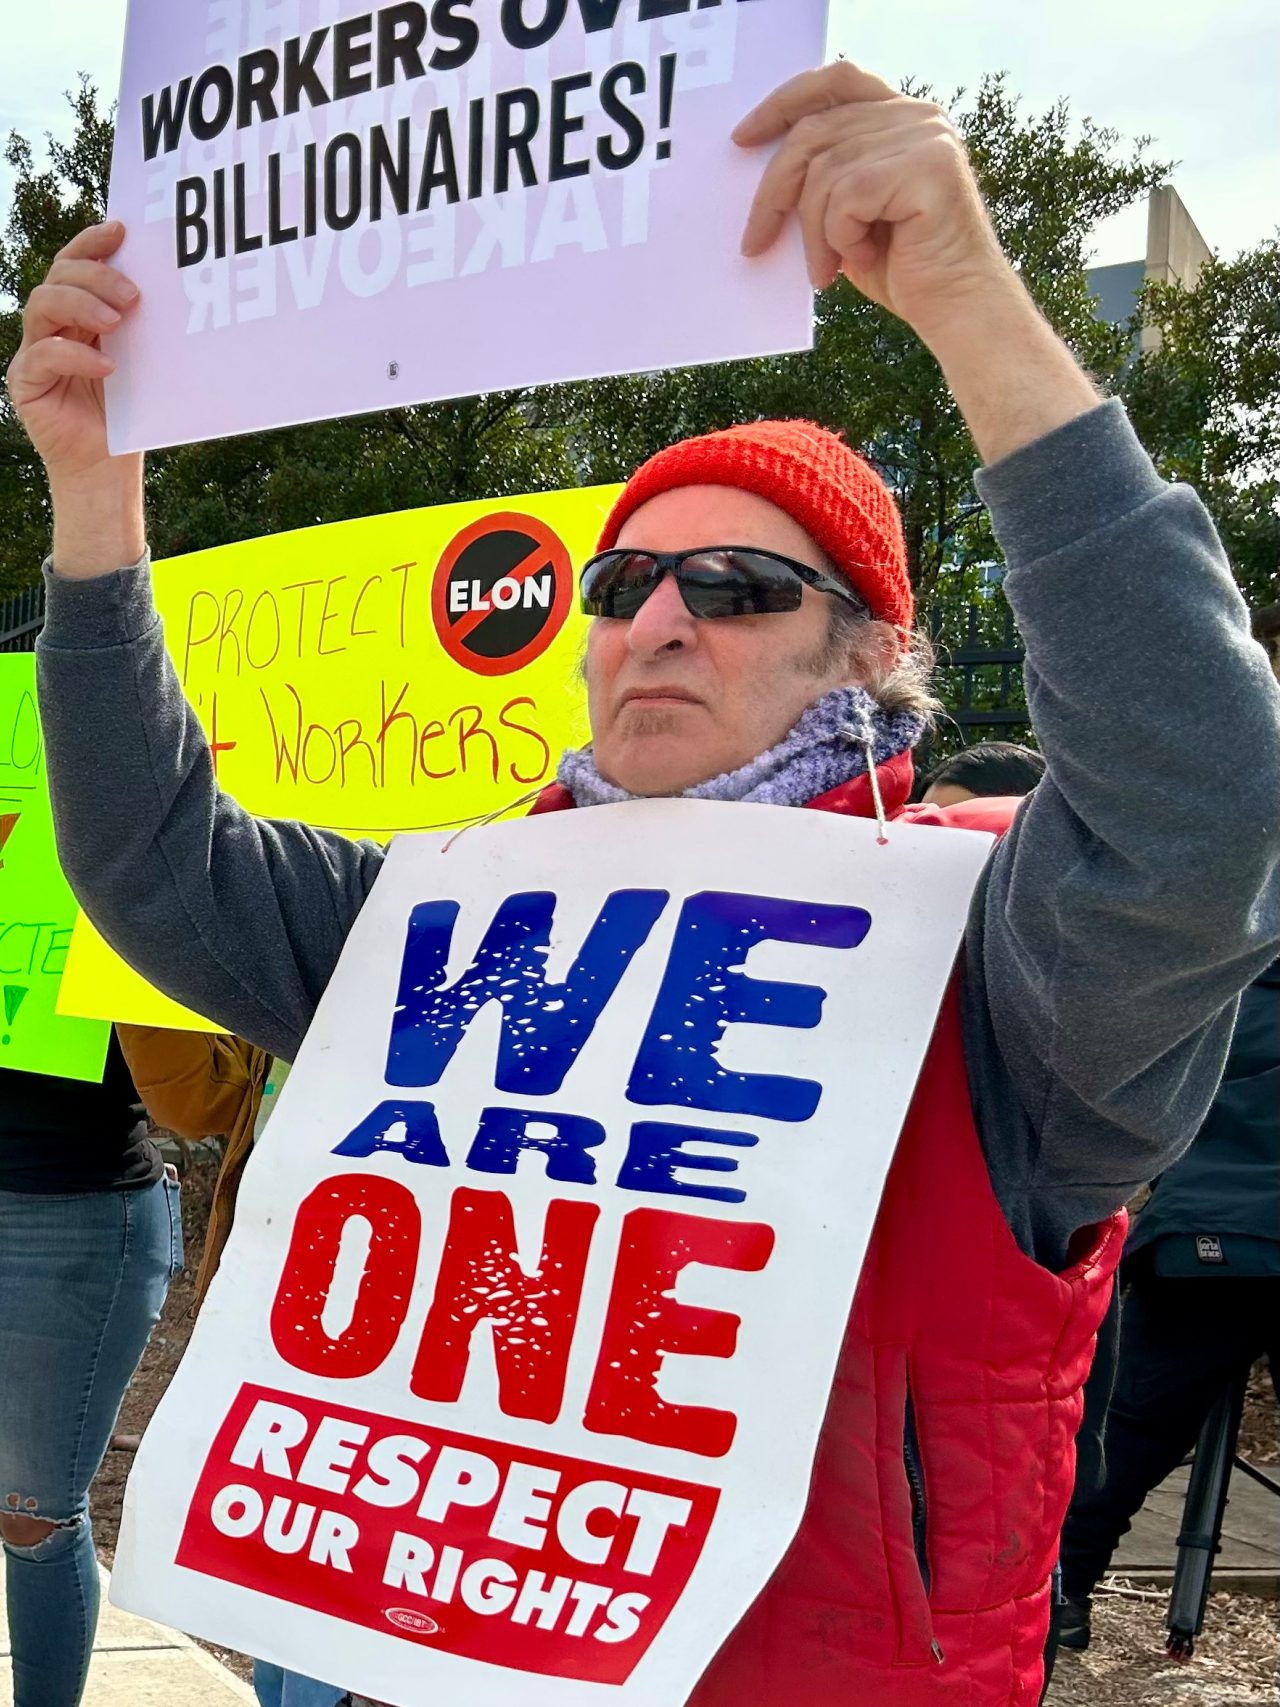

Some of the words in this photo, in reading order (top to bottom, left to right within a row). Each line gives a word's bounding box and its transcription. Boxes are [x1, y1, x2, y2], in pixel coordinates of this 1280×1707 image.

[141, 0, 480, 162] WORKERS
[176, 53, 677, 269] BILLIONAIRES!
[183, 562, 417, 686] PROTECT
[449, 574, 552, 613] ELON
[383, 888, 872, 1122] WE
[331, 1099, 760, 1203] ARE
[269, 1172, 776, 1458] ONE
[209, 1484, 365, 1575] OUR
[383, 1532, 651, 1645] RIGHTS
[230, 1399, 693, 1578] RESPECT
